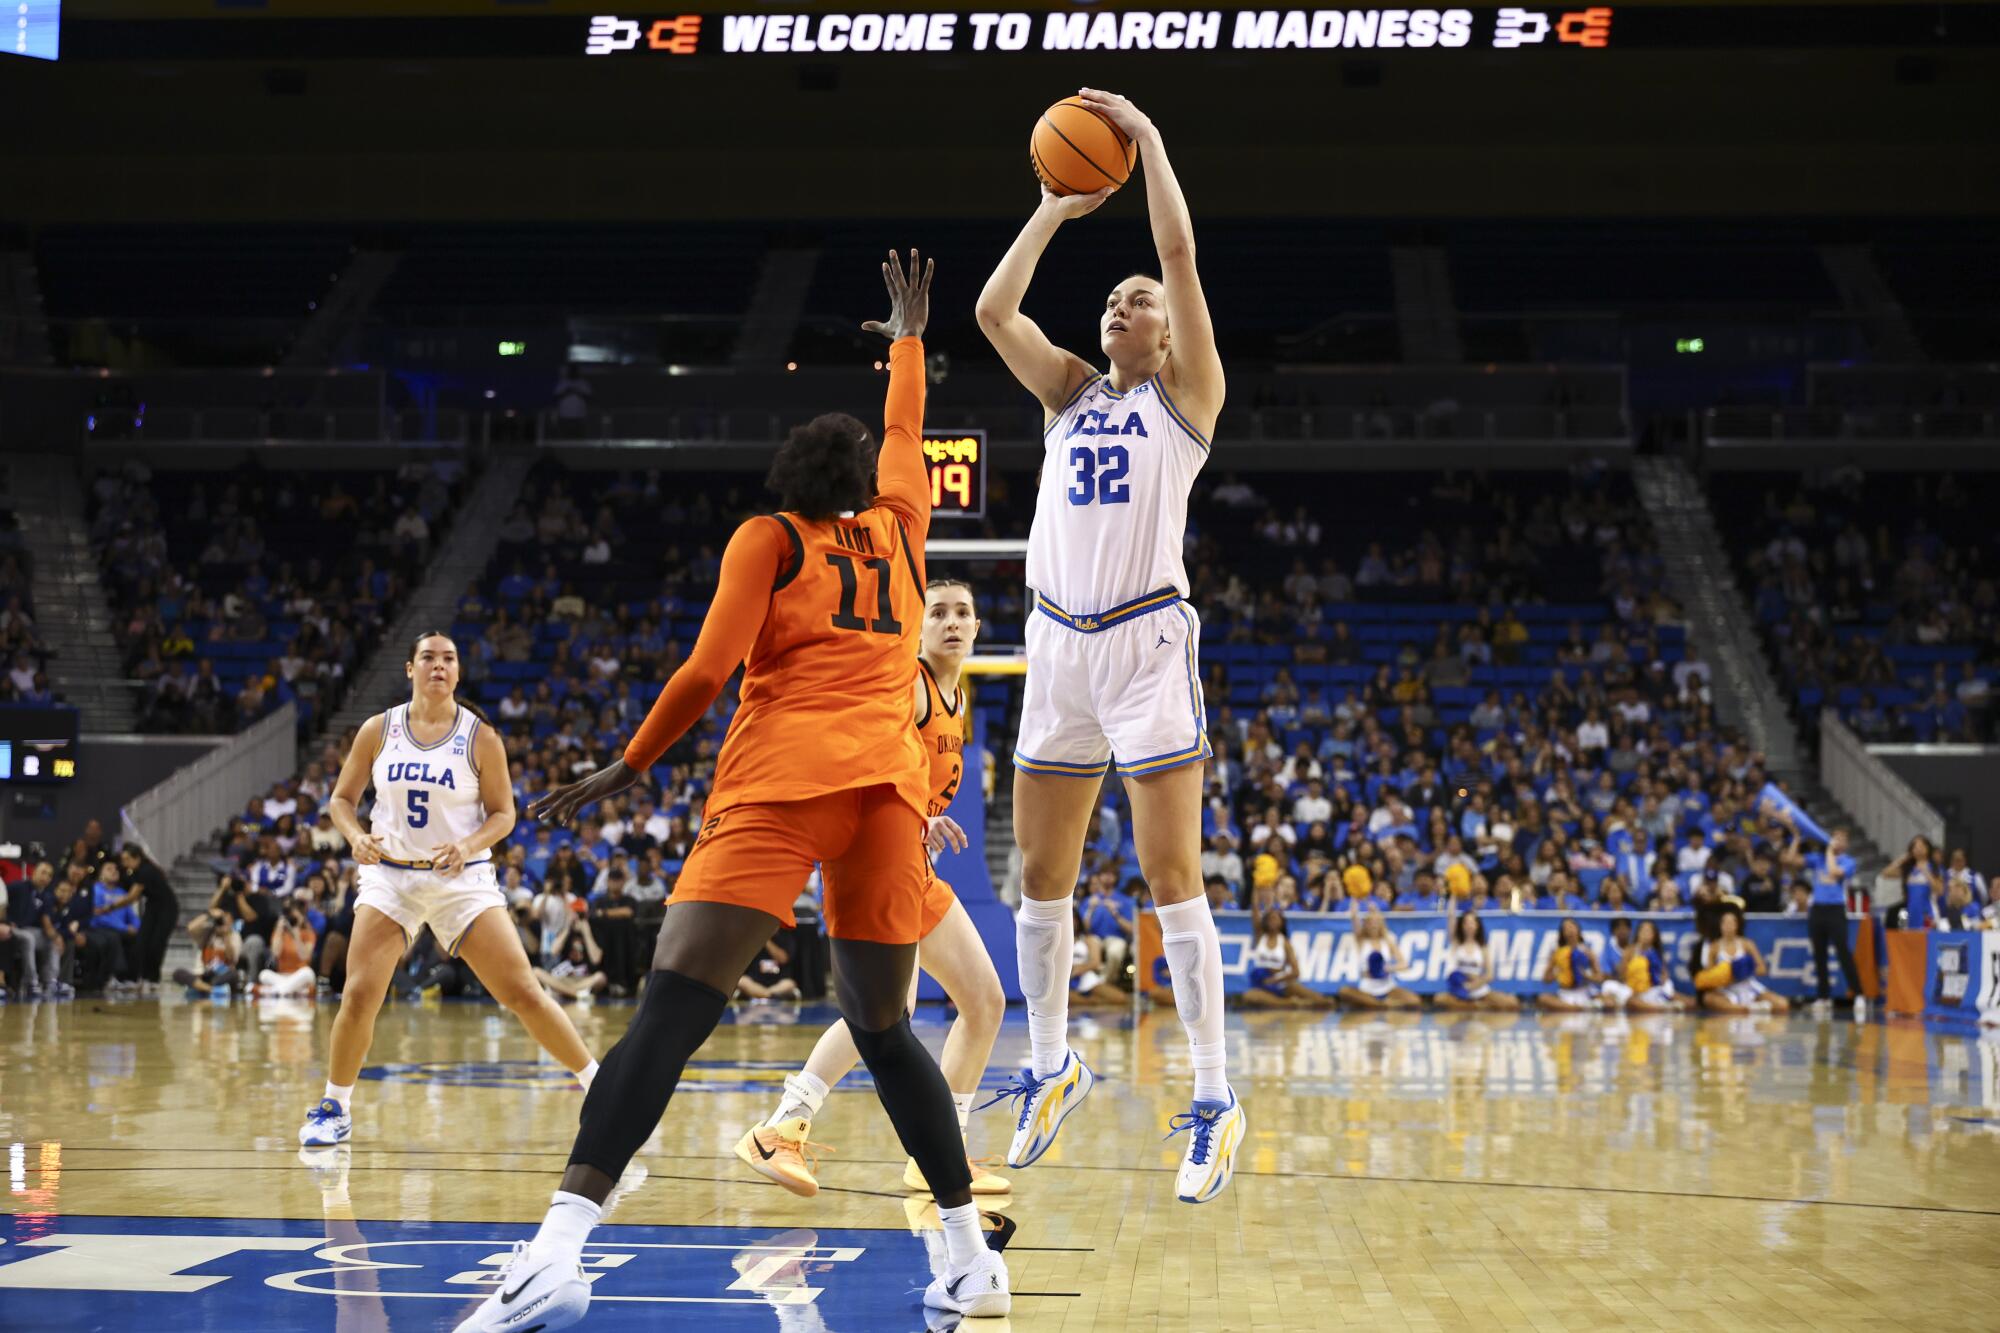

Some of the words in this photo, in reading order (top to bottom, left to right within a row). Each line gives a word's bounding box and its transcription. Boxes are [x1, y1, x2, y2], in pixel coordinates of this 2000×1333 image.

[722, 14, 957, 53] WELCOME
[969, 13, 1032, 51] TO
[1043, 11, 1222, 51] MARCH
[1231, 9, 1473, 49] MADNESS
[1065, 409, 1148, 441] UCLA
[922, 437, 977, 463] 4:49
[931, 464, 971, 507] 19
[1068, 444, 1130, 506] 32
[825, 553, 902, 636] 11
[388, 762, 456, 790] UCLA
[940, 763, 959, 800] 2
[407, 789, 429, 829] 5
[1290, 929, 1456, 982] MACH
[1488, 928, 1703, 981] MADS
